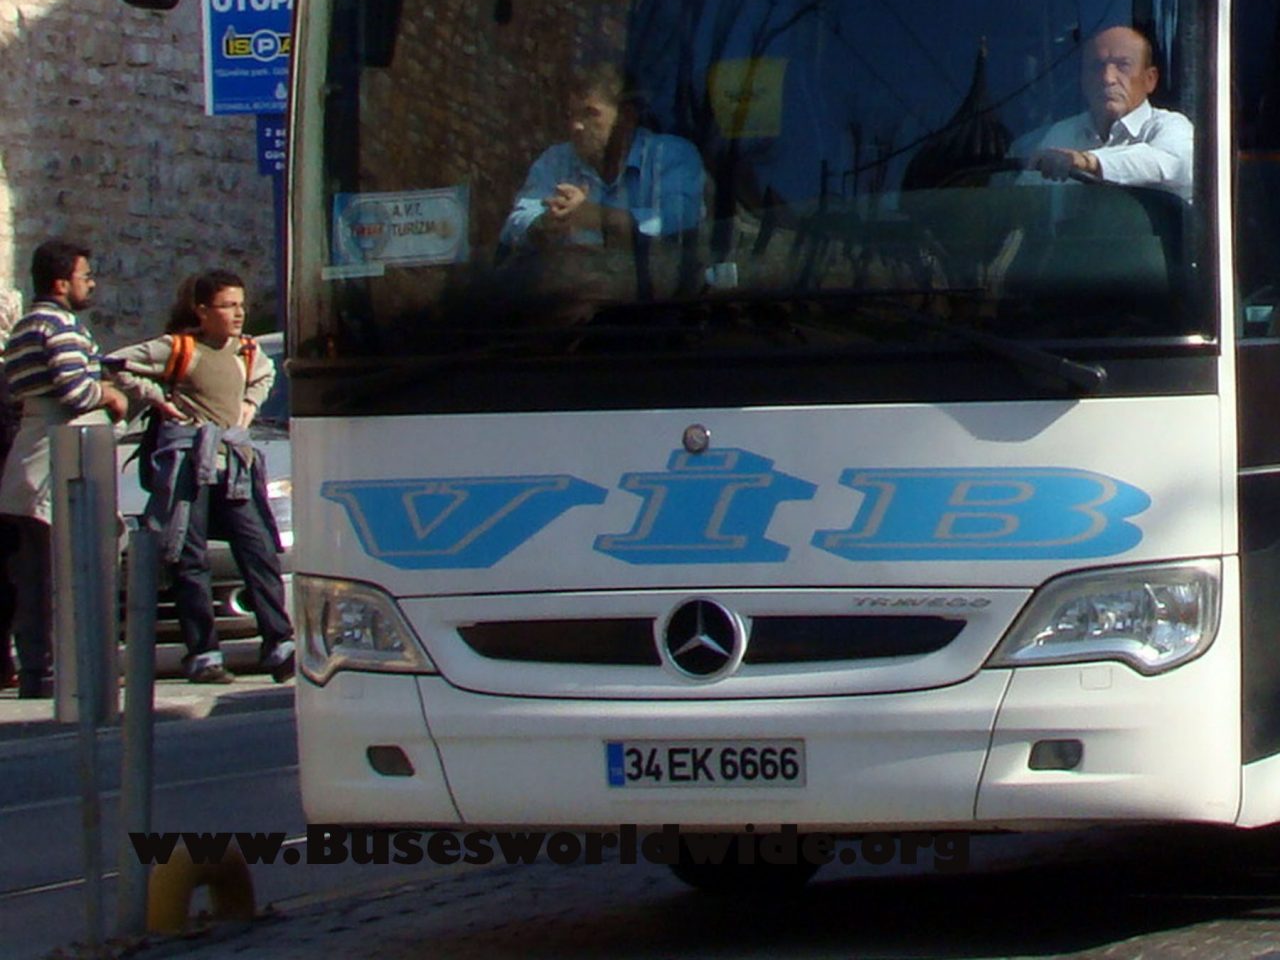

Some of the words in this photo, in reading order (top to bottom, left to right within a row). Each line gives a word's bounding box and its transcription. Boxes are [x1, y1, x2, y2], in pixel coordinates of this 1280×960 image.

[319, 447, 1153, 570] VİB
[854, 596, 992, 609] TRAVEGO
[625, 748, 663, 781] 34
[668, 747, 715, 781] EK
[720, 747, 799, 780] 6666
